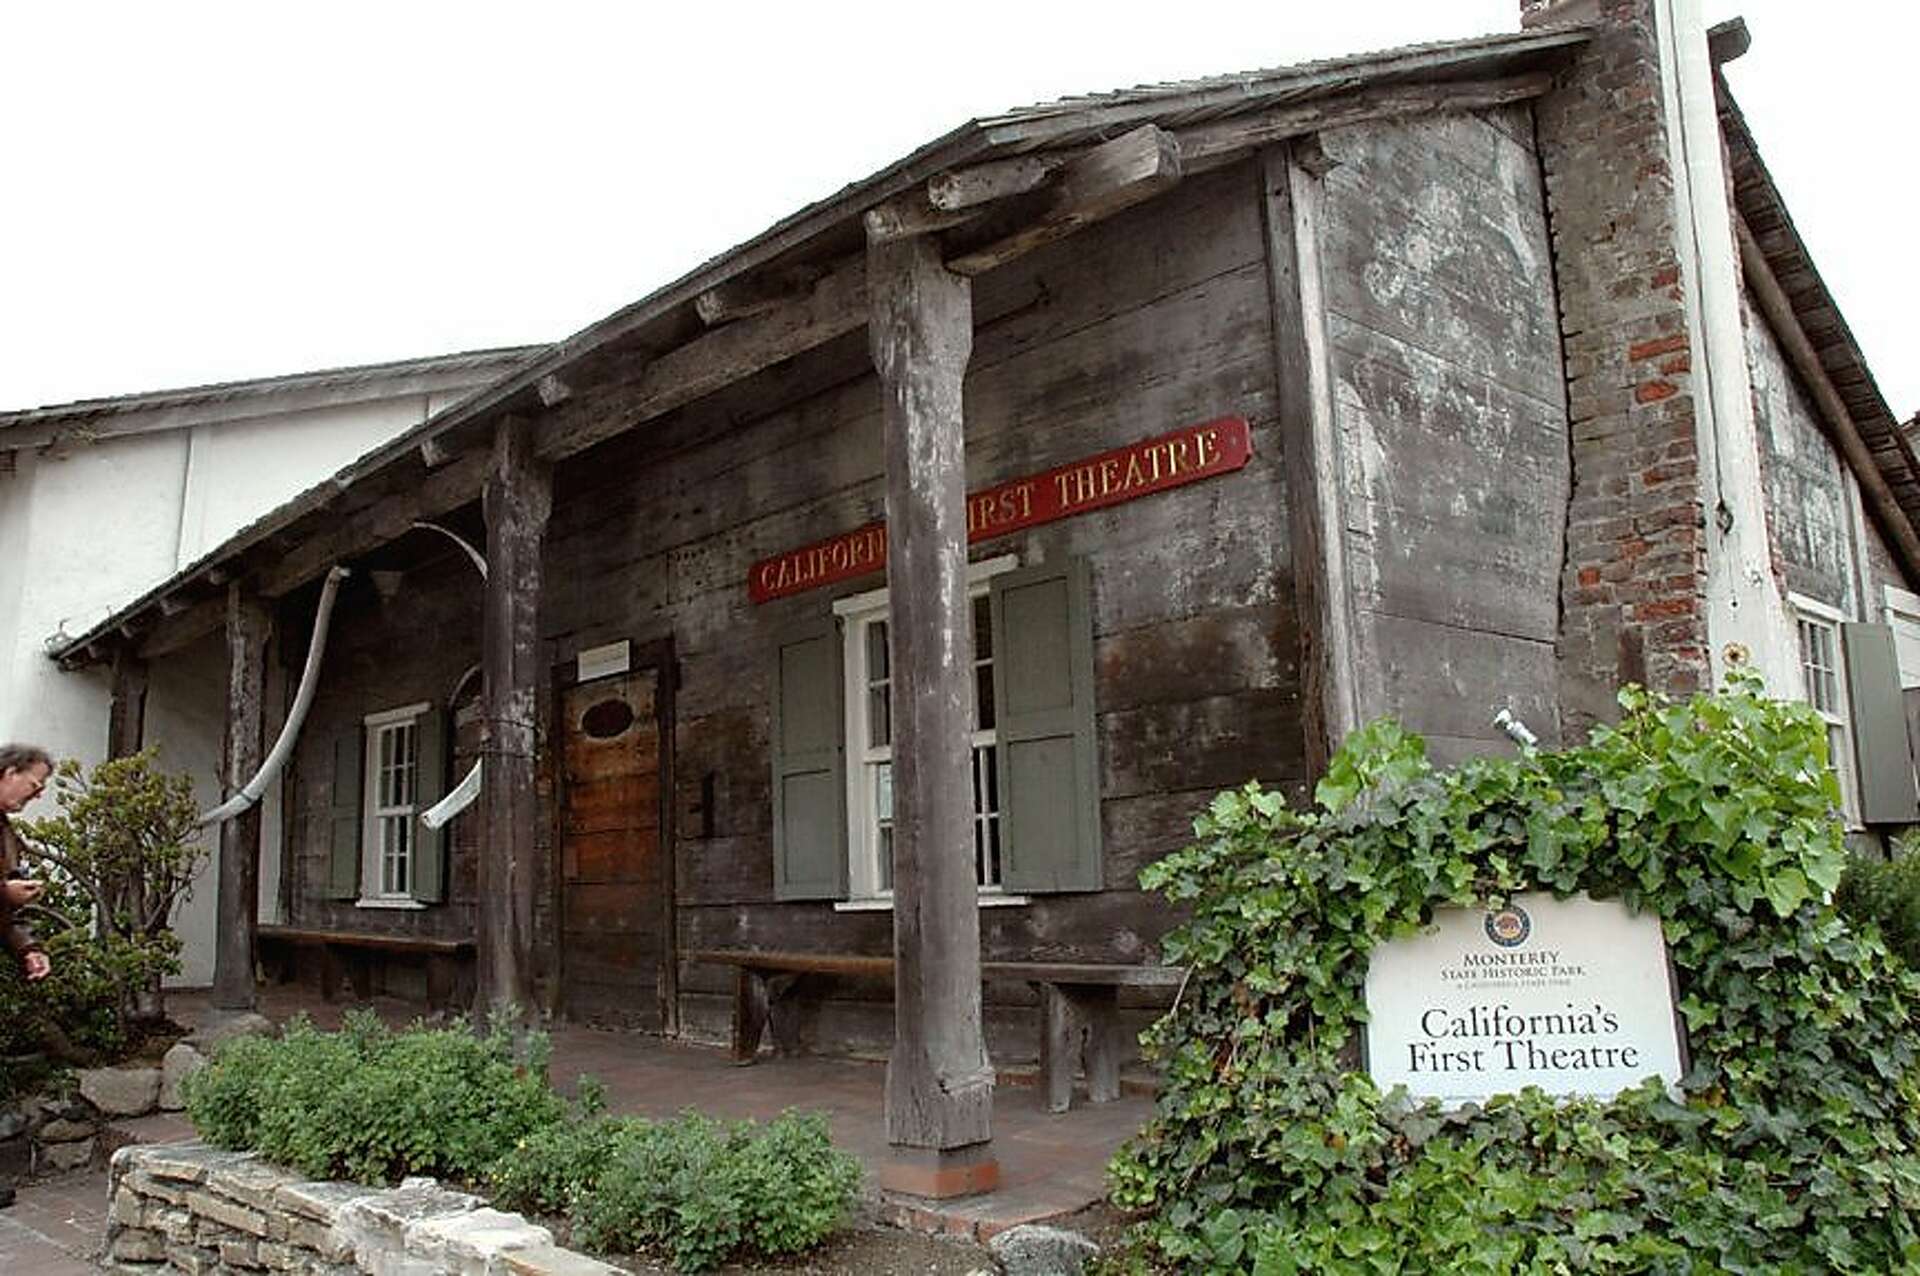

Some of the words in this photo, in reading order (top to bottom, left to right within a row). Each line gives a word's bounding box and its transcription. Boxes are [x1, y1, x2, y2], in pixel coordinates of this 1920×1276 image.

[761, 528, 886, 591] CALIFORN
[967, 482, 1034, 532] IRST
[1055, 430, 1221, 508] THEATRE
[1441, 969, 1477, 981] STATE
[1483, 967, 1547, 980] HISTORIC
[1551, 965, 1586, 977] PARK
[1463, 950, 1560, 968] MONTEREY
[1421, 1003, 1619, 1039] California's
[1407, 1041, 1485, 1072] First
[1493, 1039, 1640, 1071] Theatre
